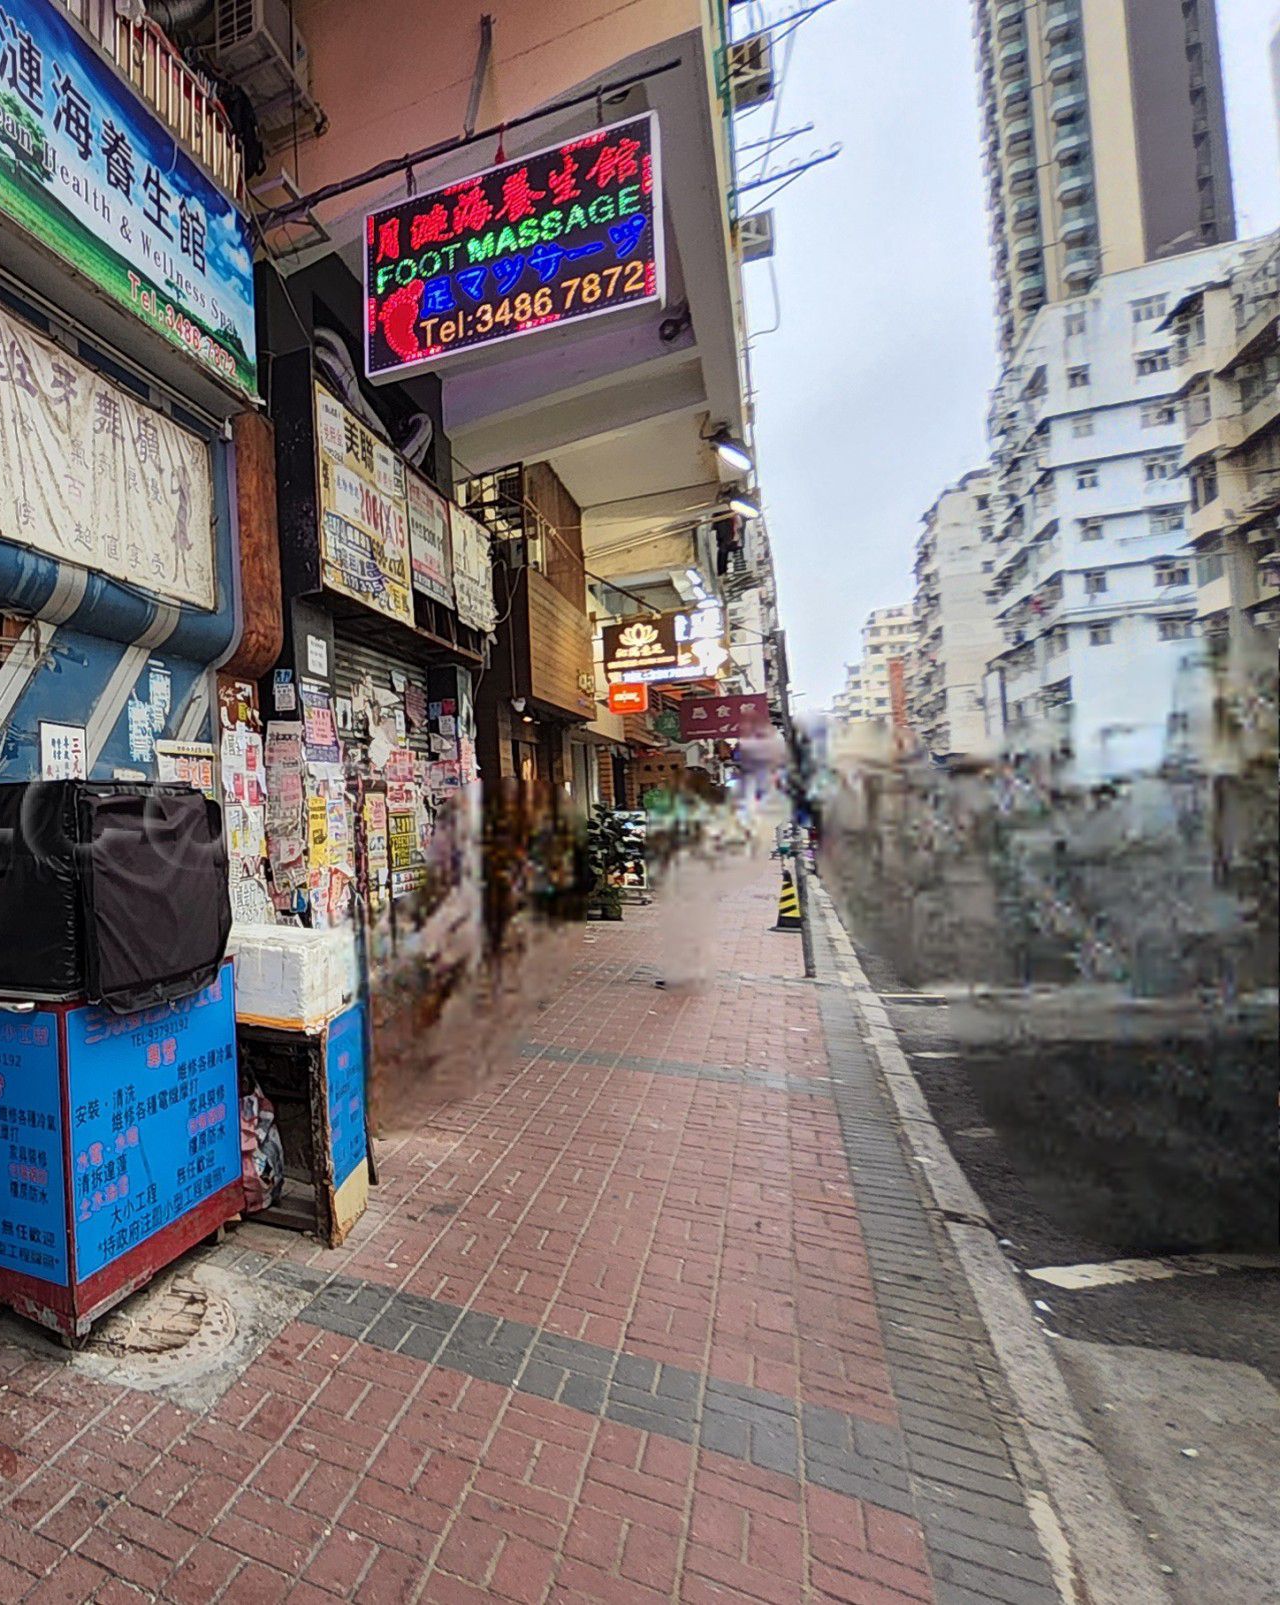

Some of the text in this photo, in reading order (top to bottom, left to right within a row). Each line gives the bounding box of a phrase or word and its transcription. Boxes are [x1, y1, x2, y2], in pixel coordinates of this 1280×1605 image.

[42, 147, 112, 226] Health
[119, 217, 133, 243] &
[140, 230, 207, 310] Wellness
[210, 296, 237, 336] Spa
[376, 184, 642, 295] FOOT MASSAGE
[420, 260, 645, 347] Tel:3486 7872
[110, 1183, 158, 1229] 大小工程
